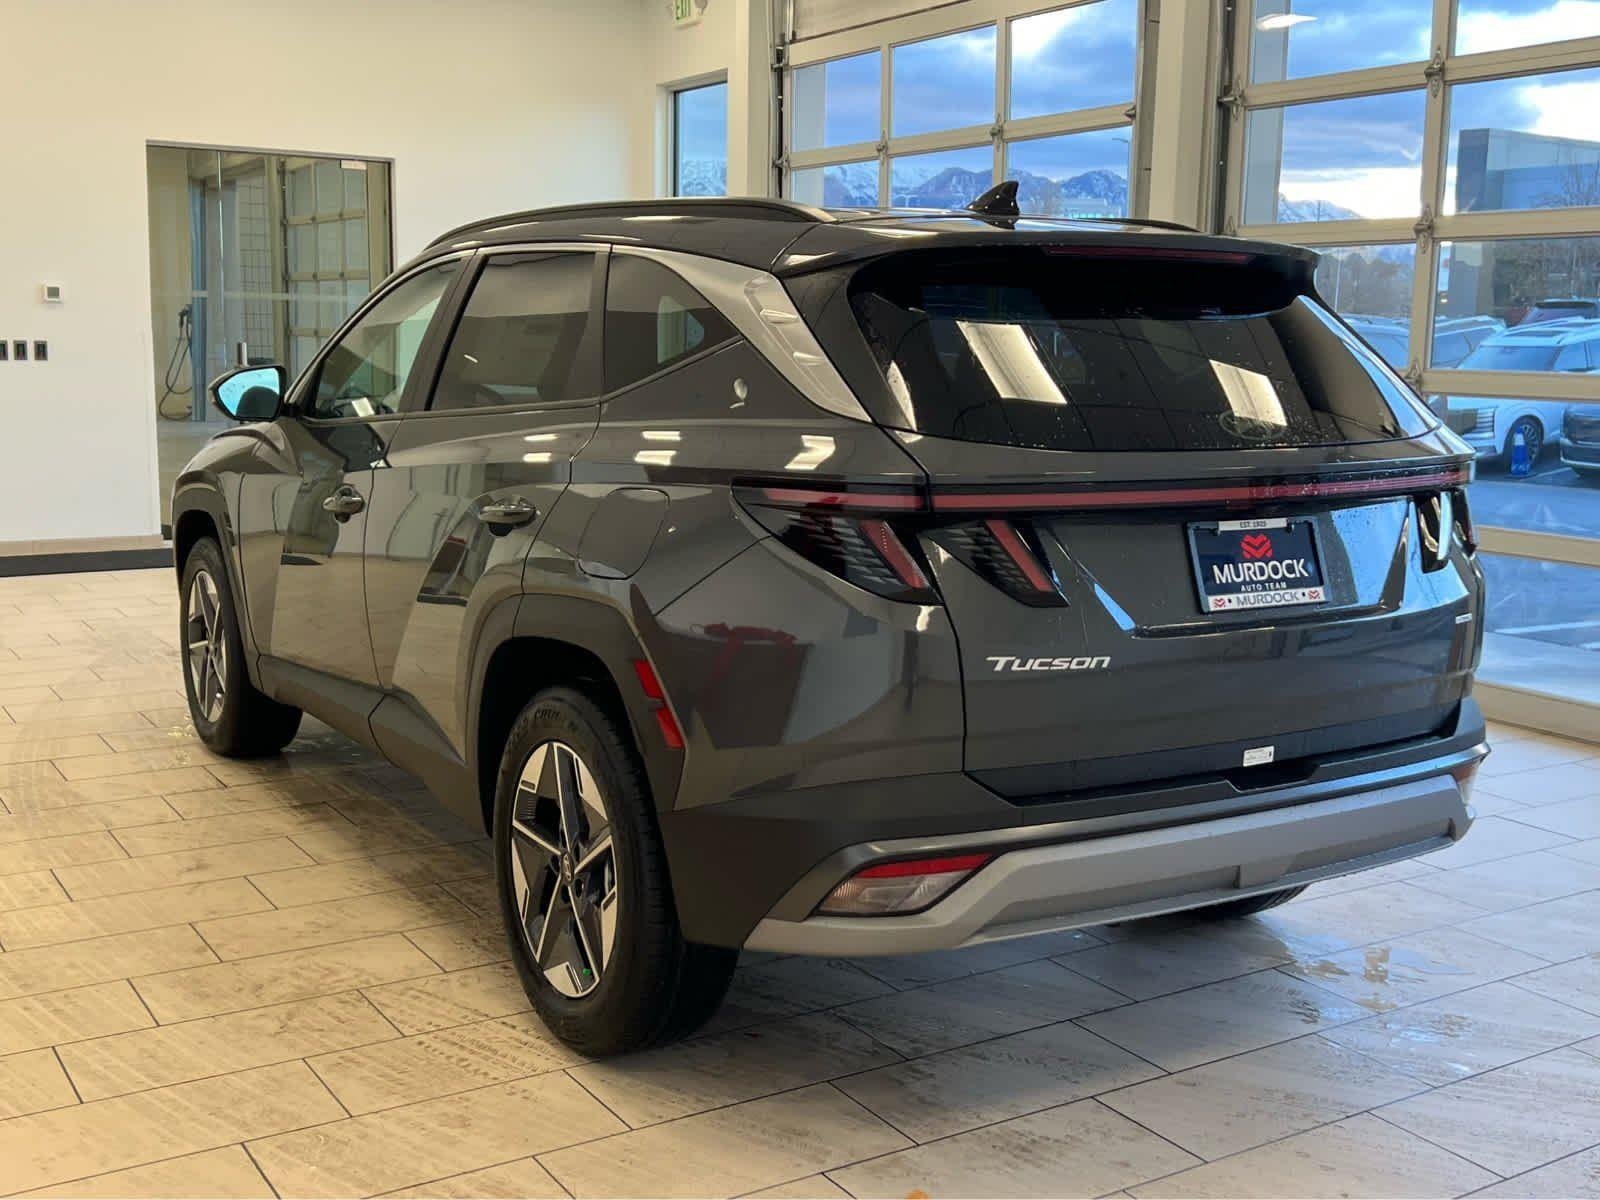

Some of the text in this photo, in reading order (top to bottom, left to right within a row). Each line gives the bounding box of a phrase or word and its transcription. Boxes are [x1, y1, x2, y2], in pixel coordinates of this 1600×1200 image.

[1212, 558, 1309, 584] MURDOCK
[1241, 581, 1287, 591] AUTO TEAM
[1236, 591, 1299, 606] MURDOCK
